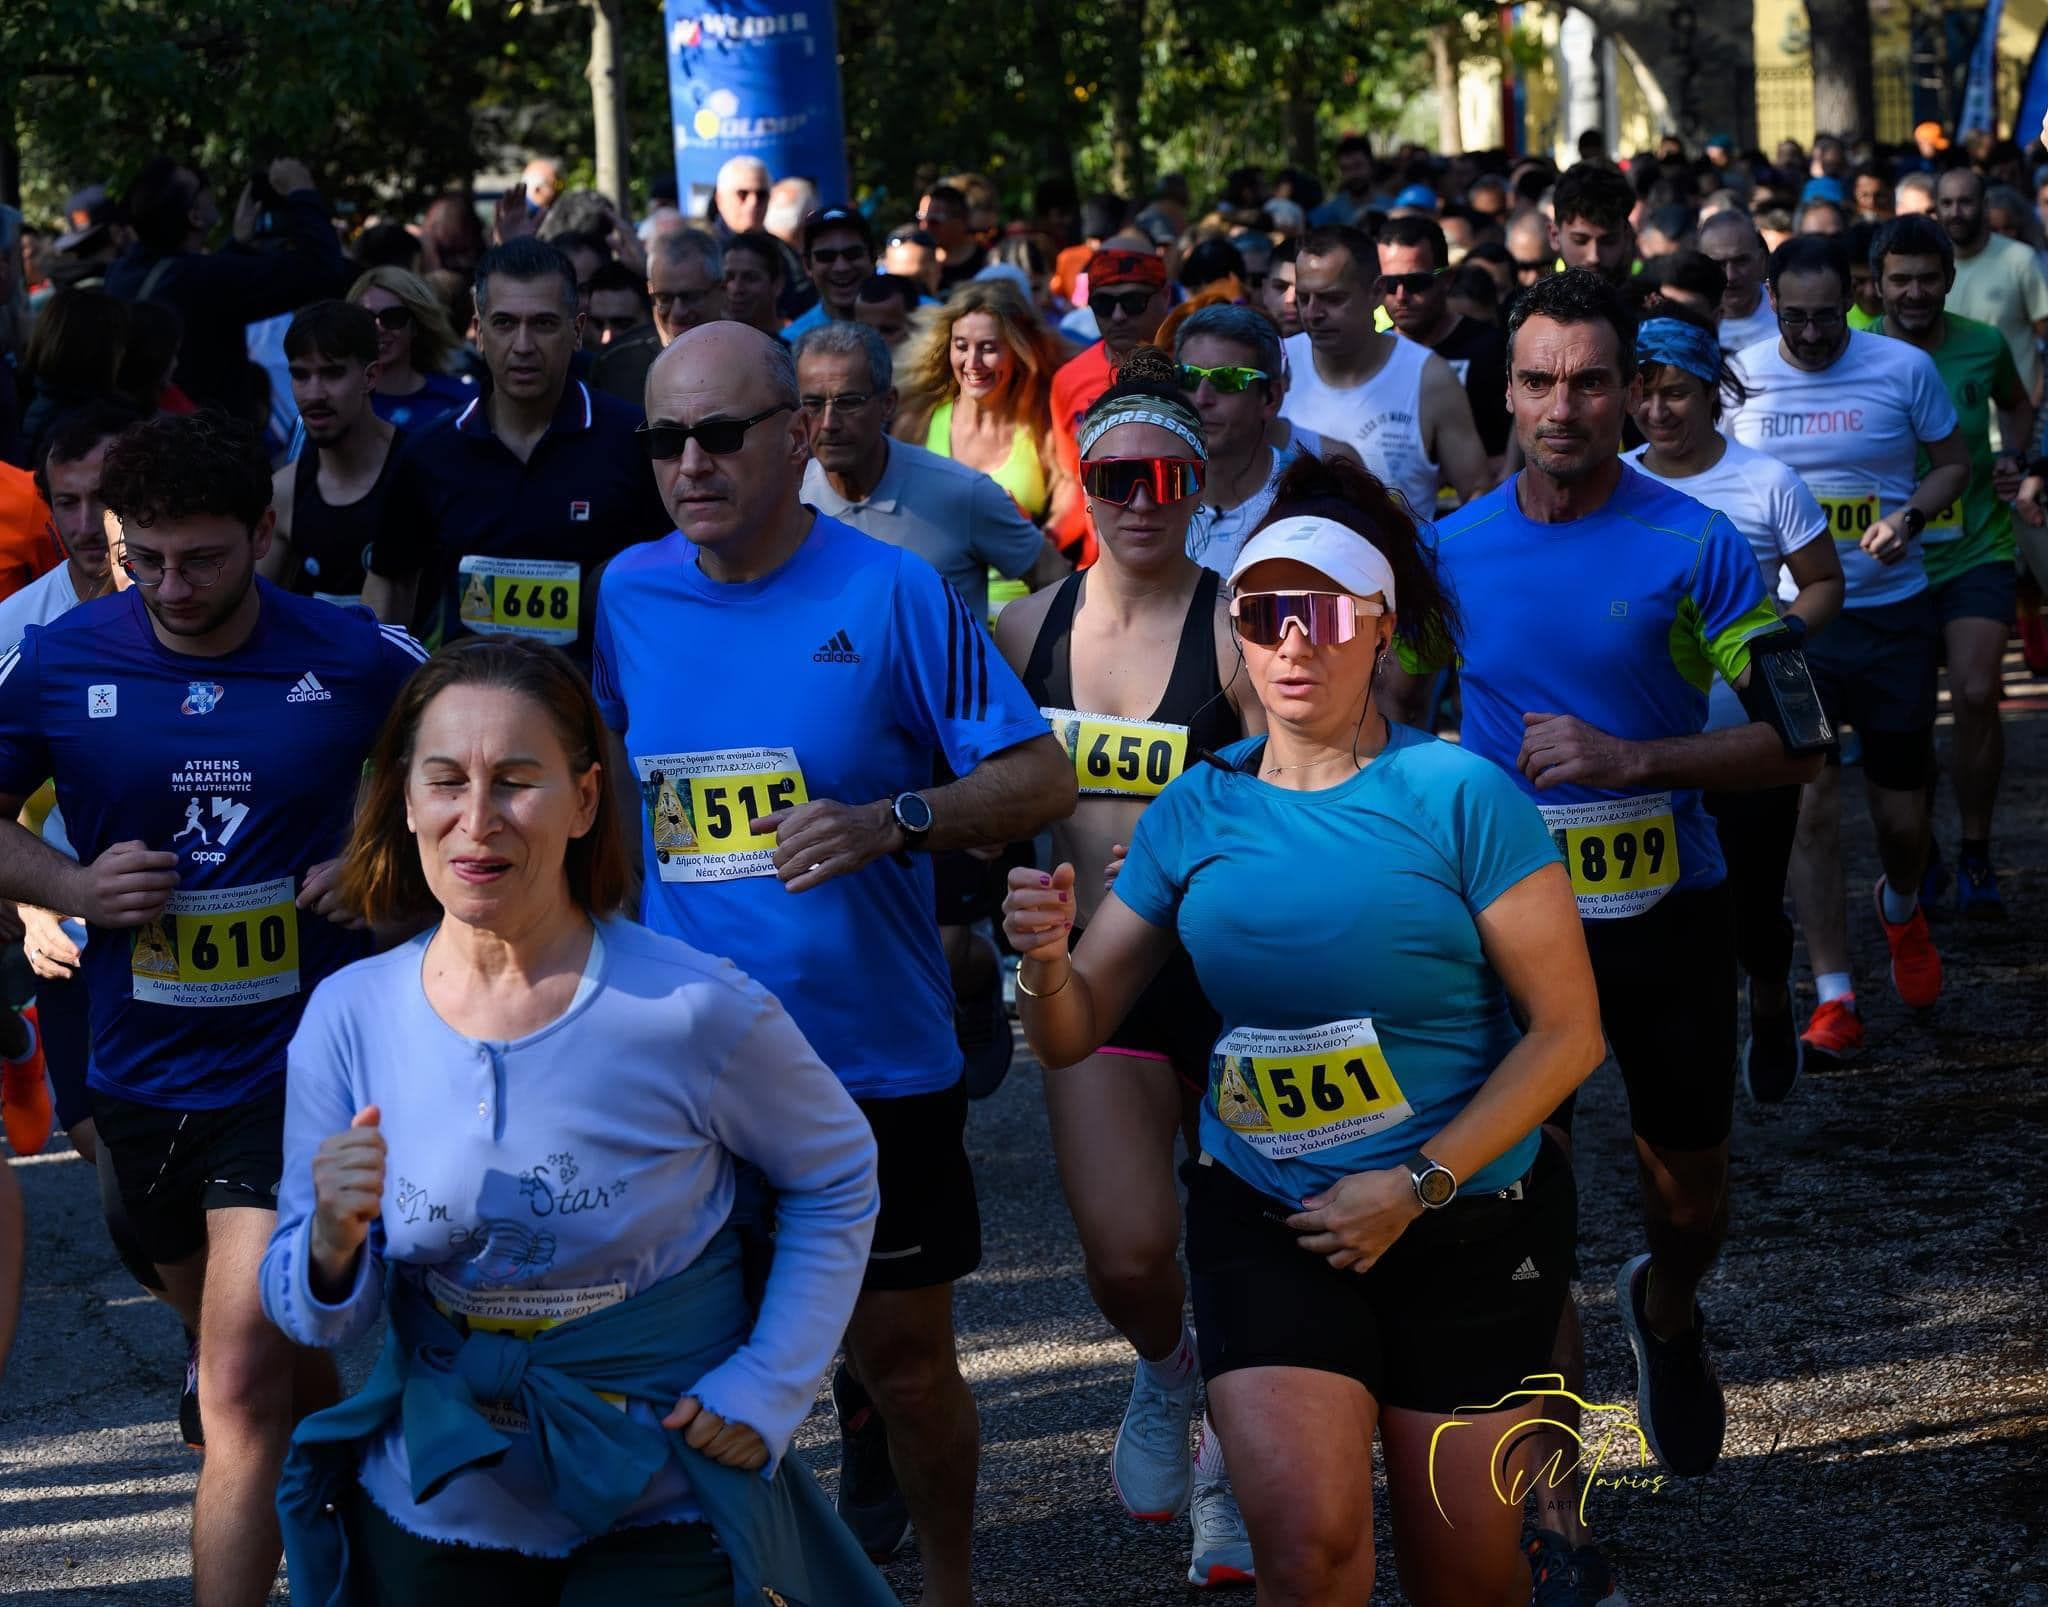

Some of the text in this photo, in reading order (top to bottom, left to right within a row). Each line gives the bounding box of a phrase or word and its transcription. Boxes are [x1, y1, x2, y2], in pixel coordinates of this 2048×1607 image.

[503, 584, 568, 619] 668
[813, 651, 860, 664] adidas
[286, 689, 332, 703] adidas
[184, 760, 240, 770] ATHENS
[1087, 733, 1172, 785] 650
[172, 772, 252, 782] MARATHON
[172, 784, 252, 792] THE AUTHENTIC
[191, 851, 226, 864] opap
[675, 851, 776, 866] Δήμος Νέας Φιλαδέλ
[1581, 828, 1665, 882] 899
[696, 863, 777, 878] Νέας Χαλκηδόνα
[191, 915, 286, 971] 610
[184, 983, 208, 993] Νέας
[173, 994, 198, 1004] Νέας
[1269, 1058, 1381, 1118] 561
[1249, 1112, 1386, 1145] Δήμος Νέας Φιλαδέλφειας
[1272, 1127, 1367, 1156] Νέας Χαλκηδόνας
[531, 1165, 610, 1217] Star
[1511, 1270, 1541, 1281] adidas
